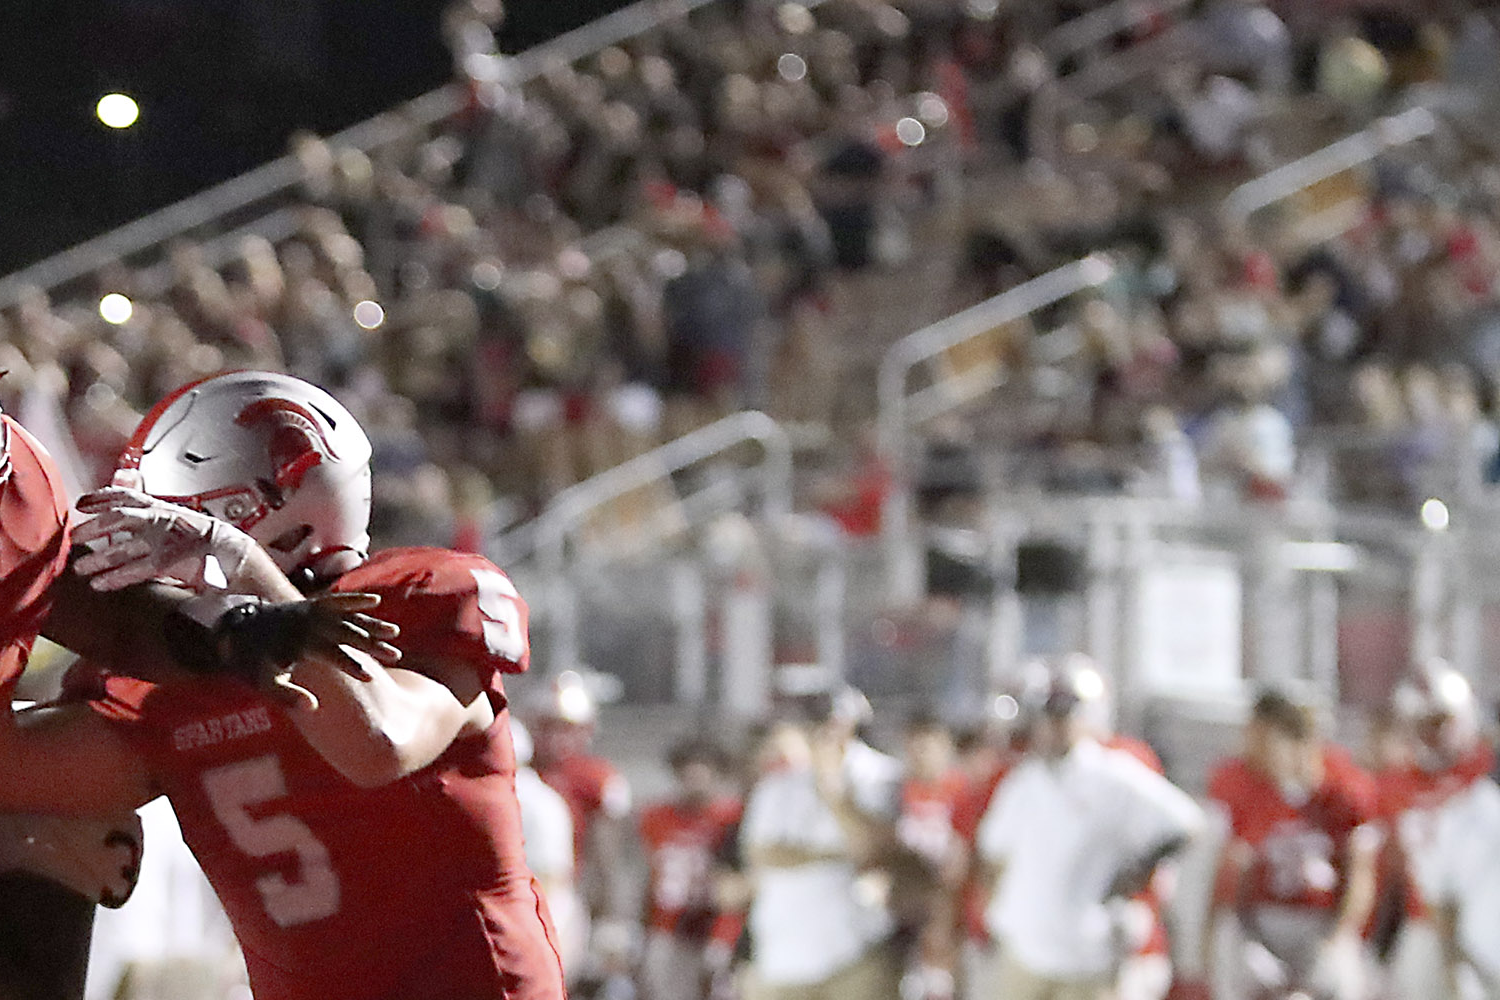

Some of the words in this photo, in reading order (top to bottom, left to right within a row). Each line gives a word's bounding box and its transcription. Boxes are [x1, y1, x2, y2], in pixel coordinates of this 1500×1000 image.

[469, 568, 525, 664] 5
[173, 706, 272, 751] SPARTANS
[203, 753, 342, 929] 5
